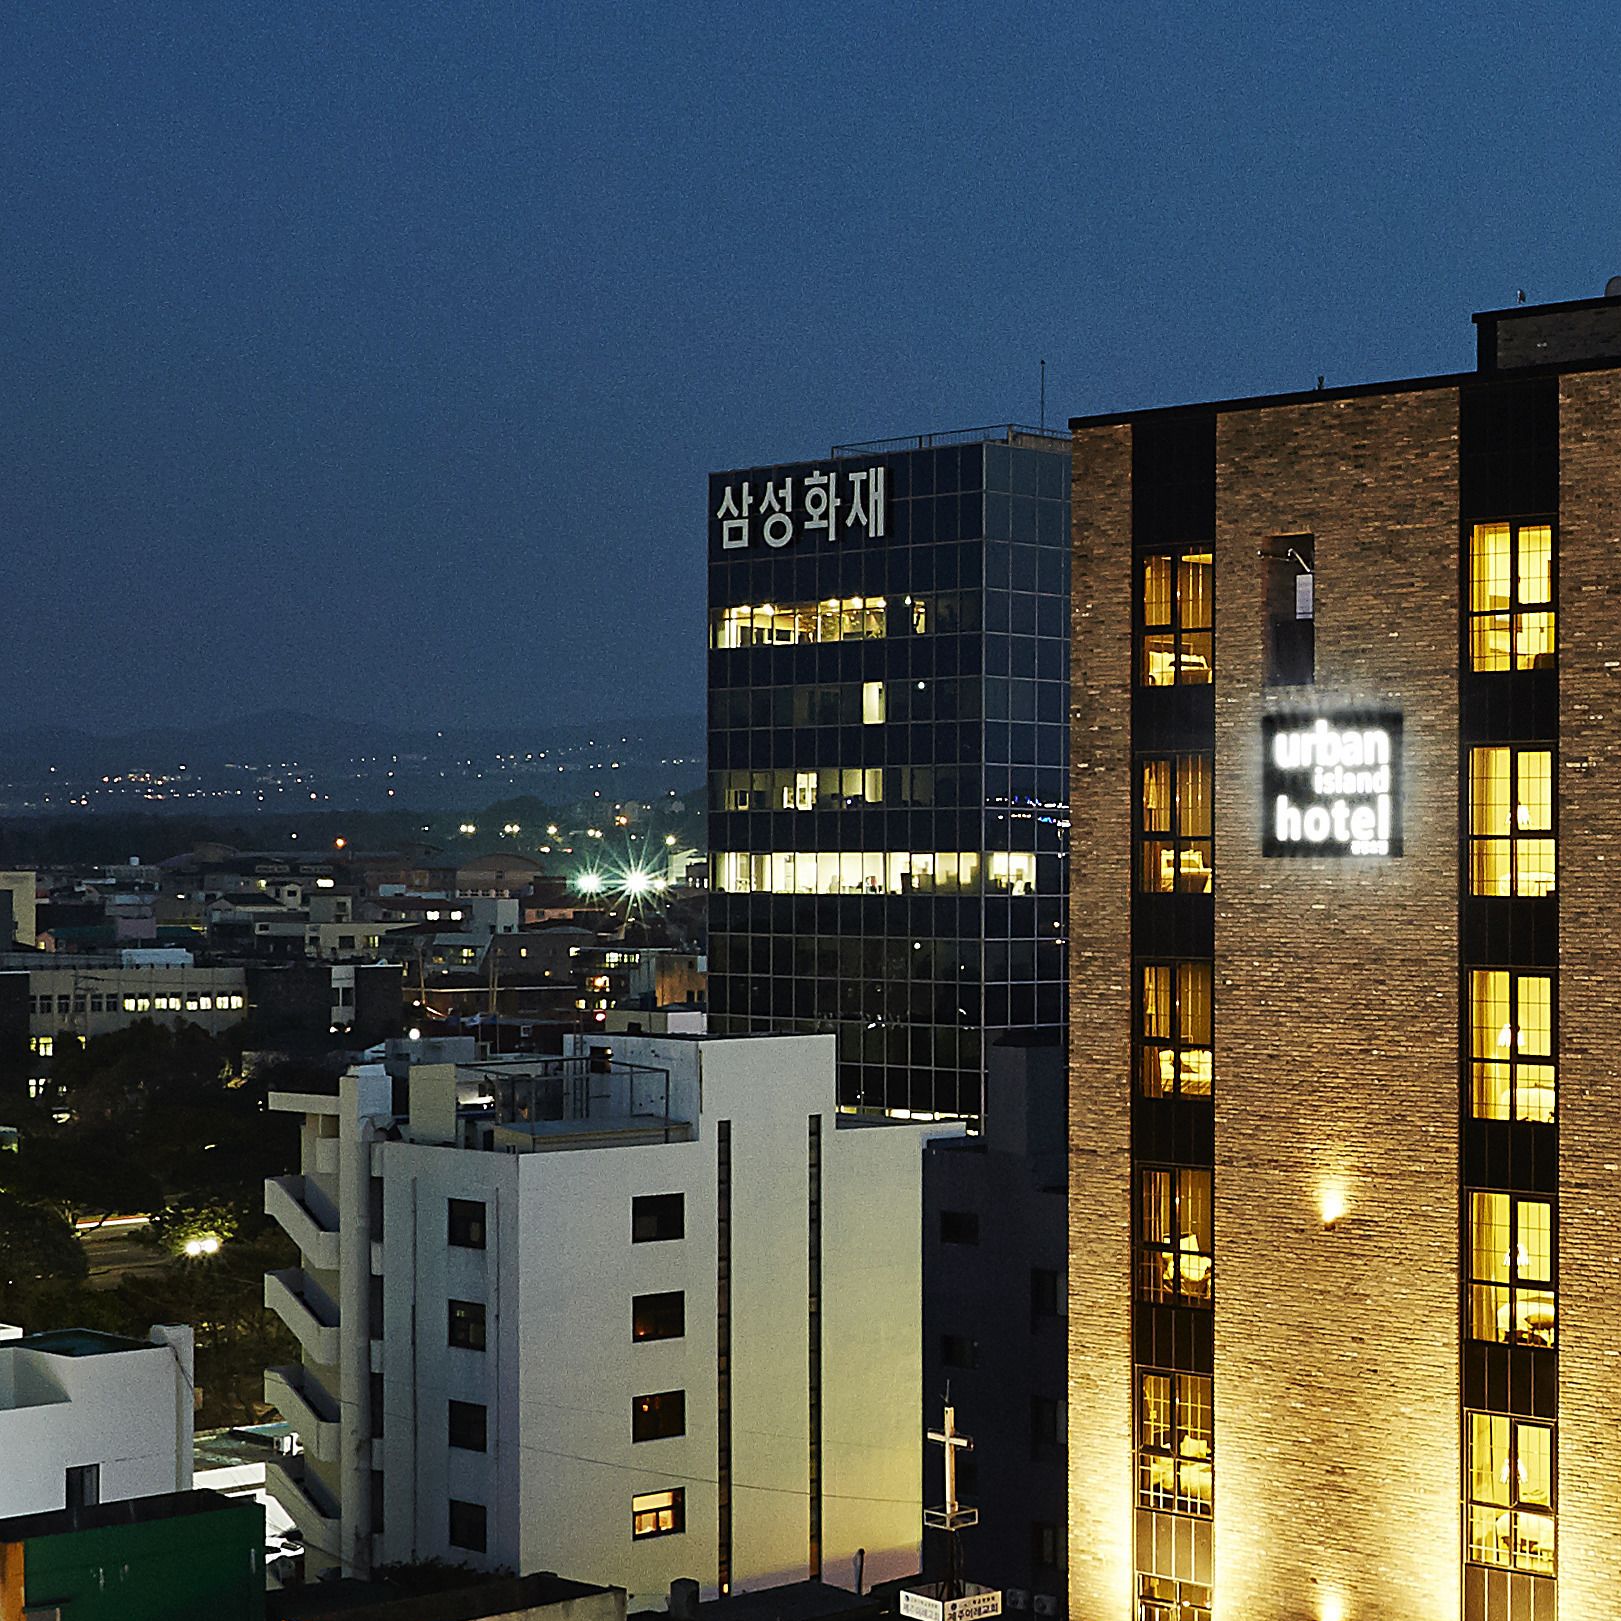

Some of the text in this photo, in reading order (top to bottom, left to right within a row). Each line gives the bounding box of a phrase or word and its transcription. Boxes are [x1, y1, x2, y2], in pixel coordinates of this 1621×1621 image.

[716, 466, 885, 550] 삼성화재
[1274, 719, 1390, 768] urban
[1313, 764, 1390, 794] island
[1275, 794, 1390, 842] hotel
